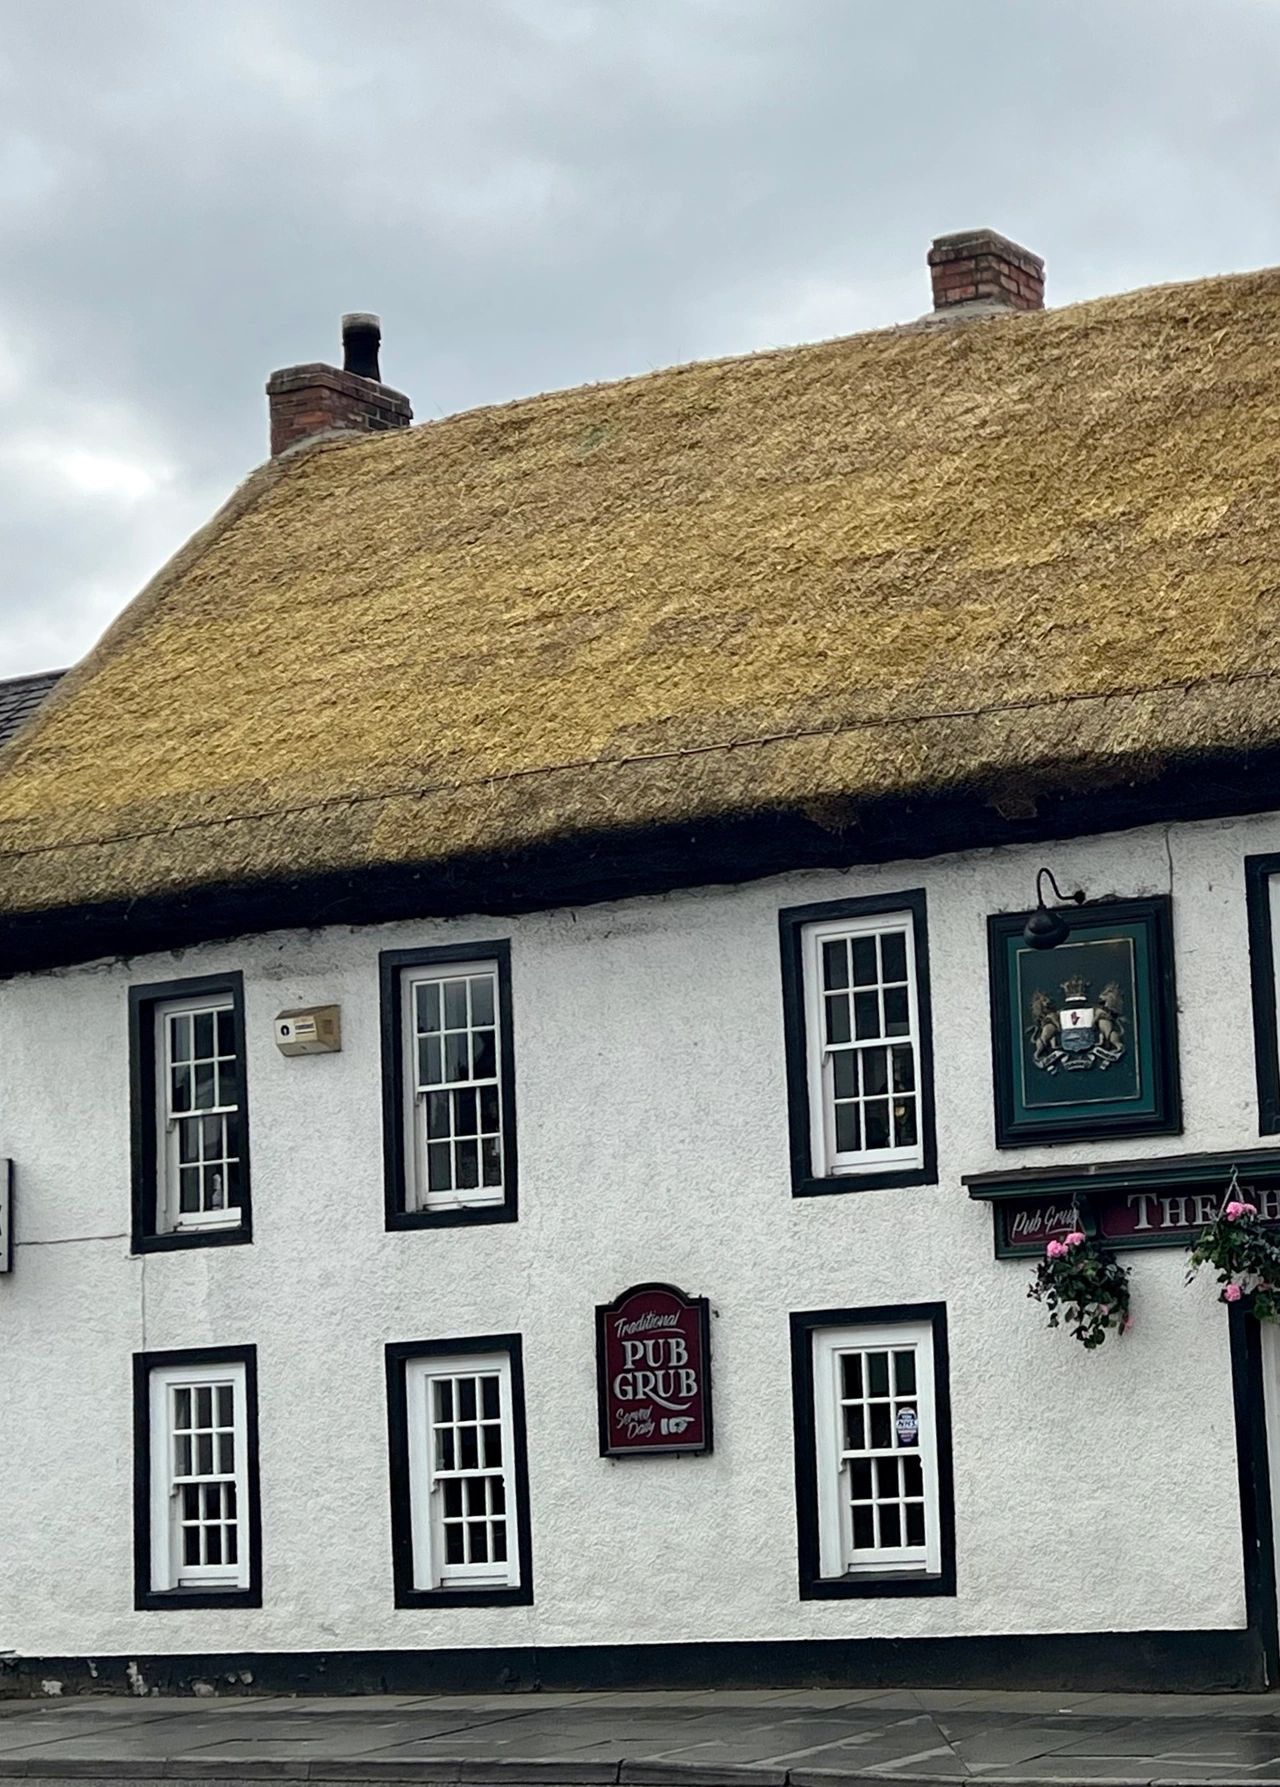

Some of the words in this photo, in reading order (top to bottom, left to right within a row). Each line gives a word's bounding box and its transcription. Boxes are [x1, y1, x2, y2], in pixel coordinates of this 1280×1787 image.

[1012, 1209, 1041, 1239] Pub
[1127, 1192, 1217, 1230] THE
[614, 1309, 680, 1338] Traditional
[621, 1338, 689, 1370] PUB
[613, 1368, 698, 1410] GRUB
